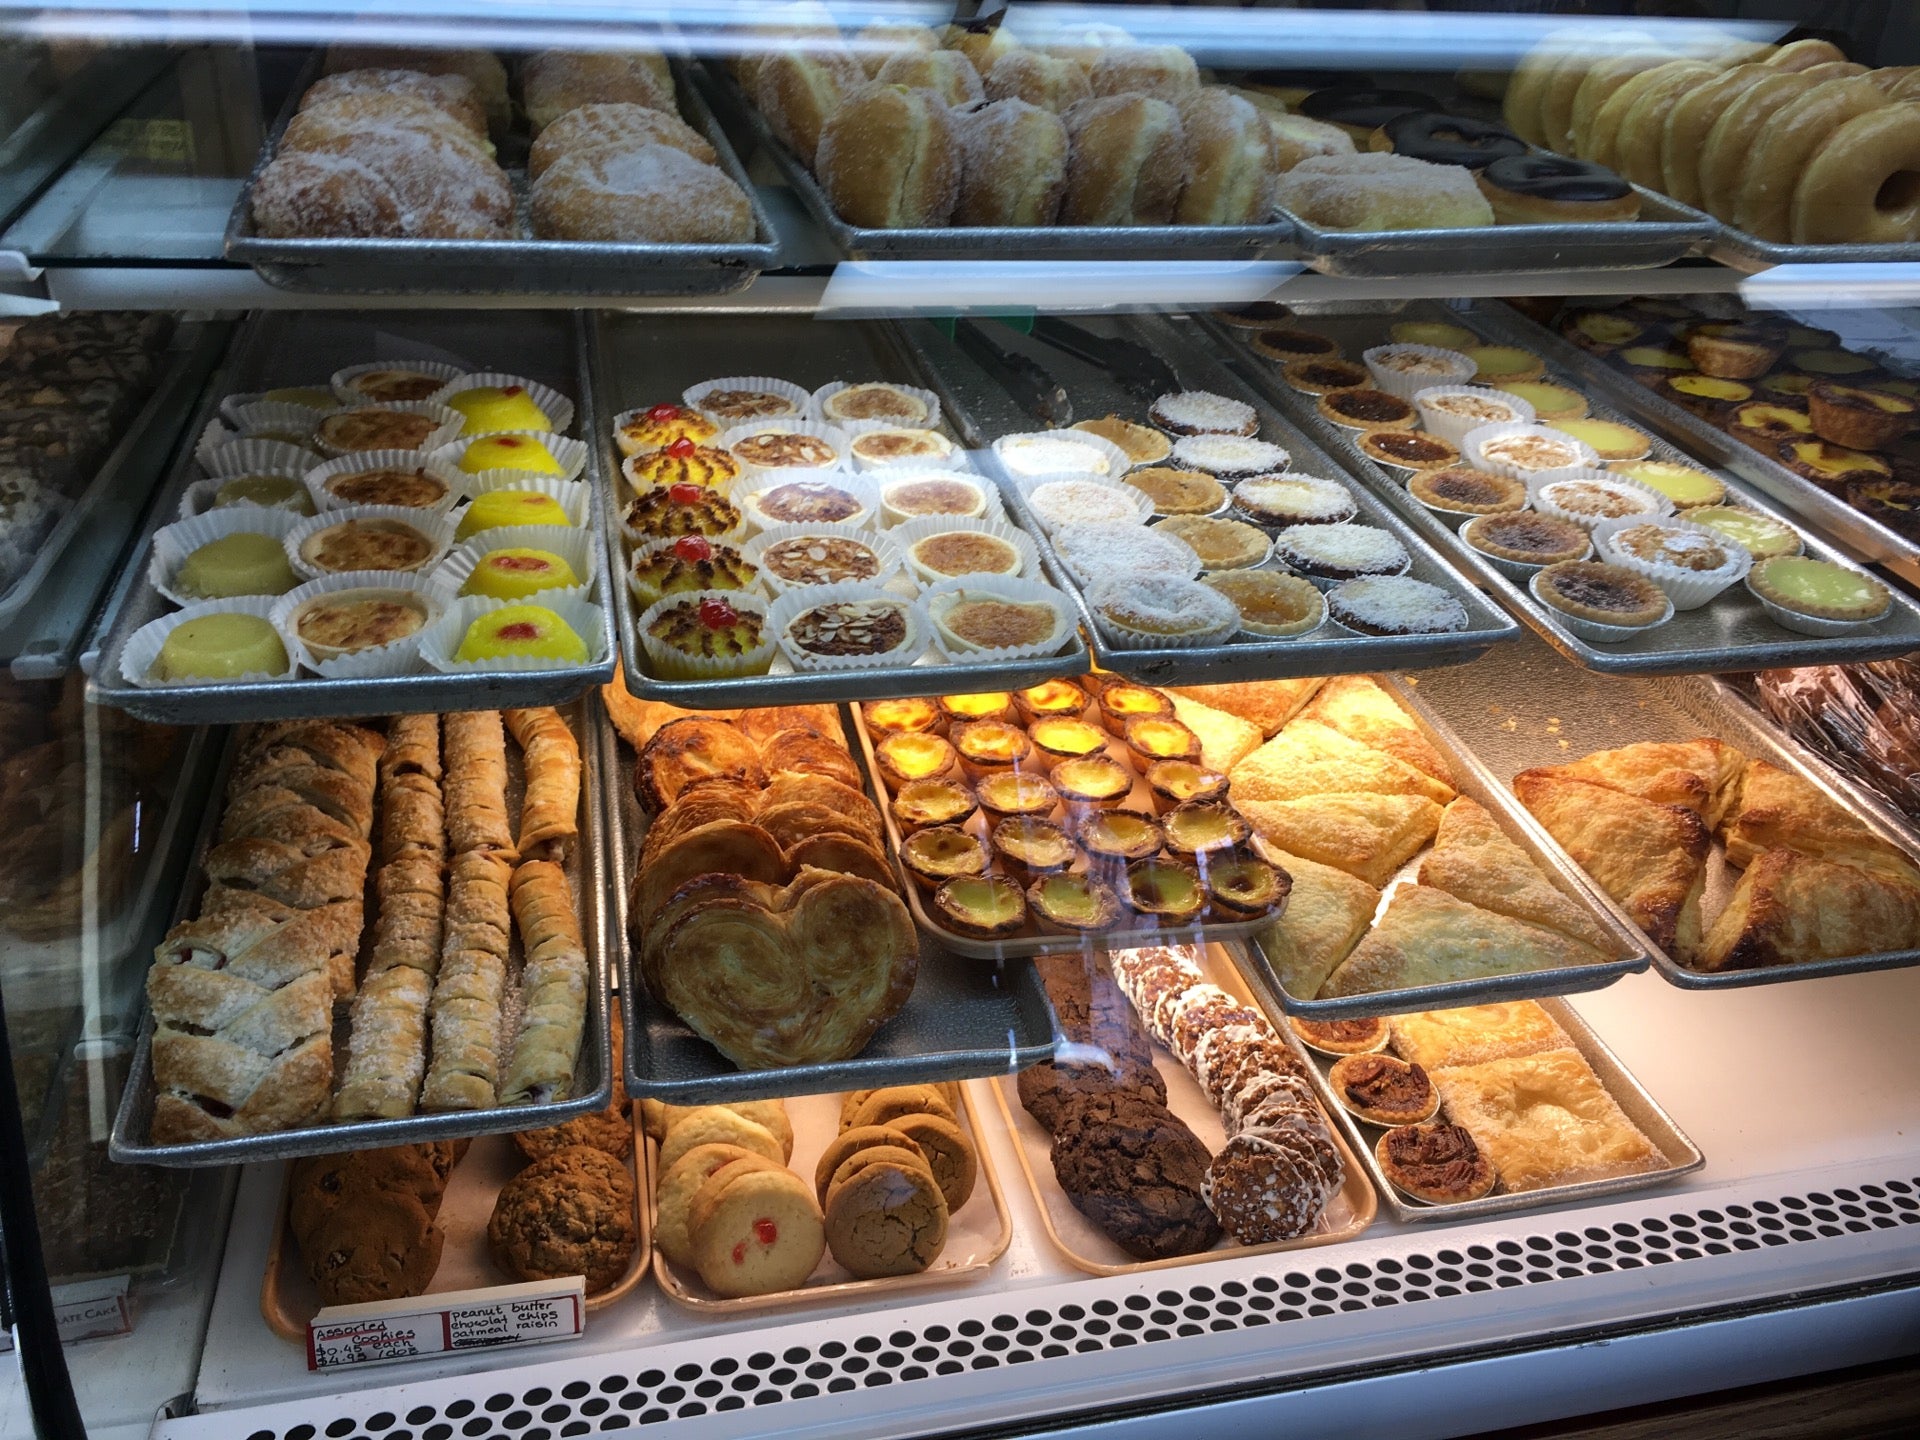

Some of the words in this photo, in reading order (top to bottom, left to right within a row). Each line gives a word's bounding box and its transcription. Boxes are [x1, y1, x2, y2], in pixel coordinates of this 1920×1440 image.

[452, 1305, 503, 1321] peanut
[511, 1300, 553, 1313] butter
[517, 1311, 559, 1321] chips
[316, 1321, 387, 1339] Assorted
[452, 1325, 508, 1338] oatmeal
[516, 1320, 558, 1330] raisin
[316, 1343, 363, 1356] $0.45
[373, 1340, 413, 1350] each
